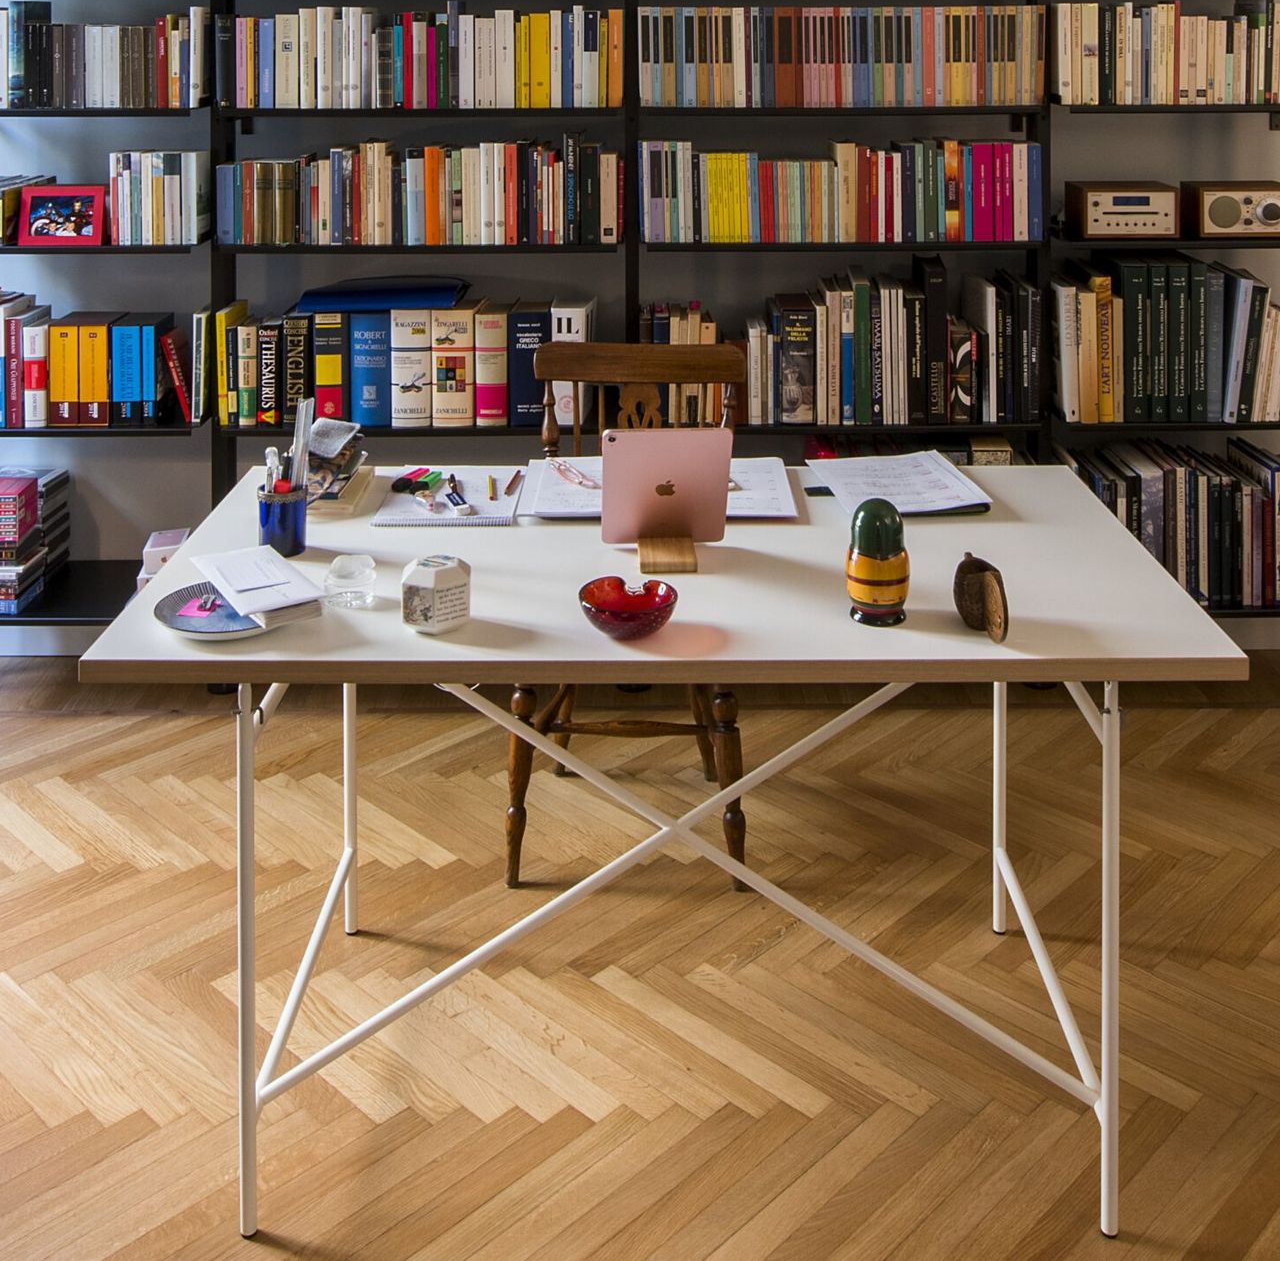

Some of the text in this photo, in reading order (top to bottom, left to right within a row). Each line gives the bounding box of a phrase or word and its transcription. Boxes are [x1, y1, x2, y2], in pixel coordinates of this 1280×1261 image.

[354, 331, 386, 339] ROBERT
[557, 318, 580, 334] IL
[1064, 294, 1072, 347] LONDRES
[262, 342, 275, 408] THESAURUS
[287, 336, 304, 408] ENGLISH
[874, 351, 882, 399] SATSUMA
[1100, 303, 1111, 394] L'ART NOUVEAU
